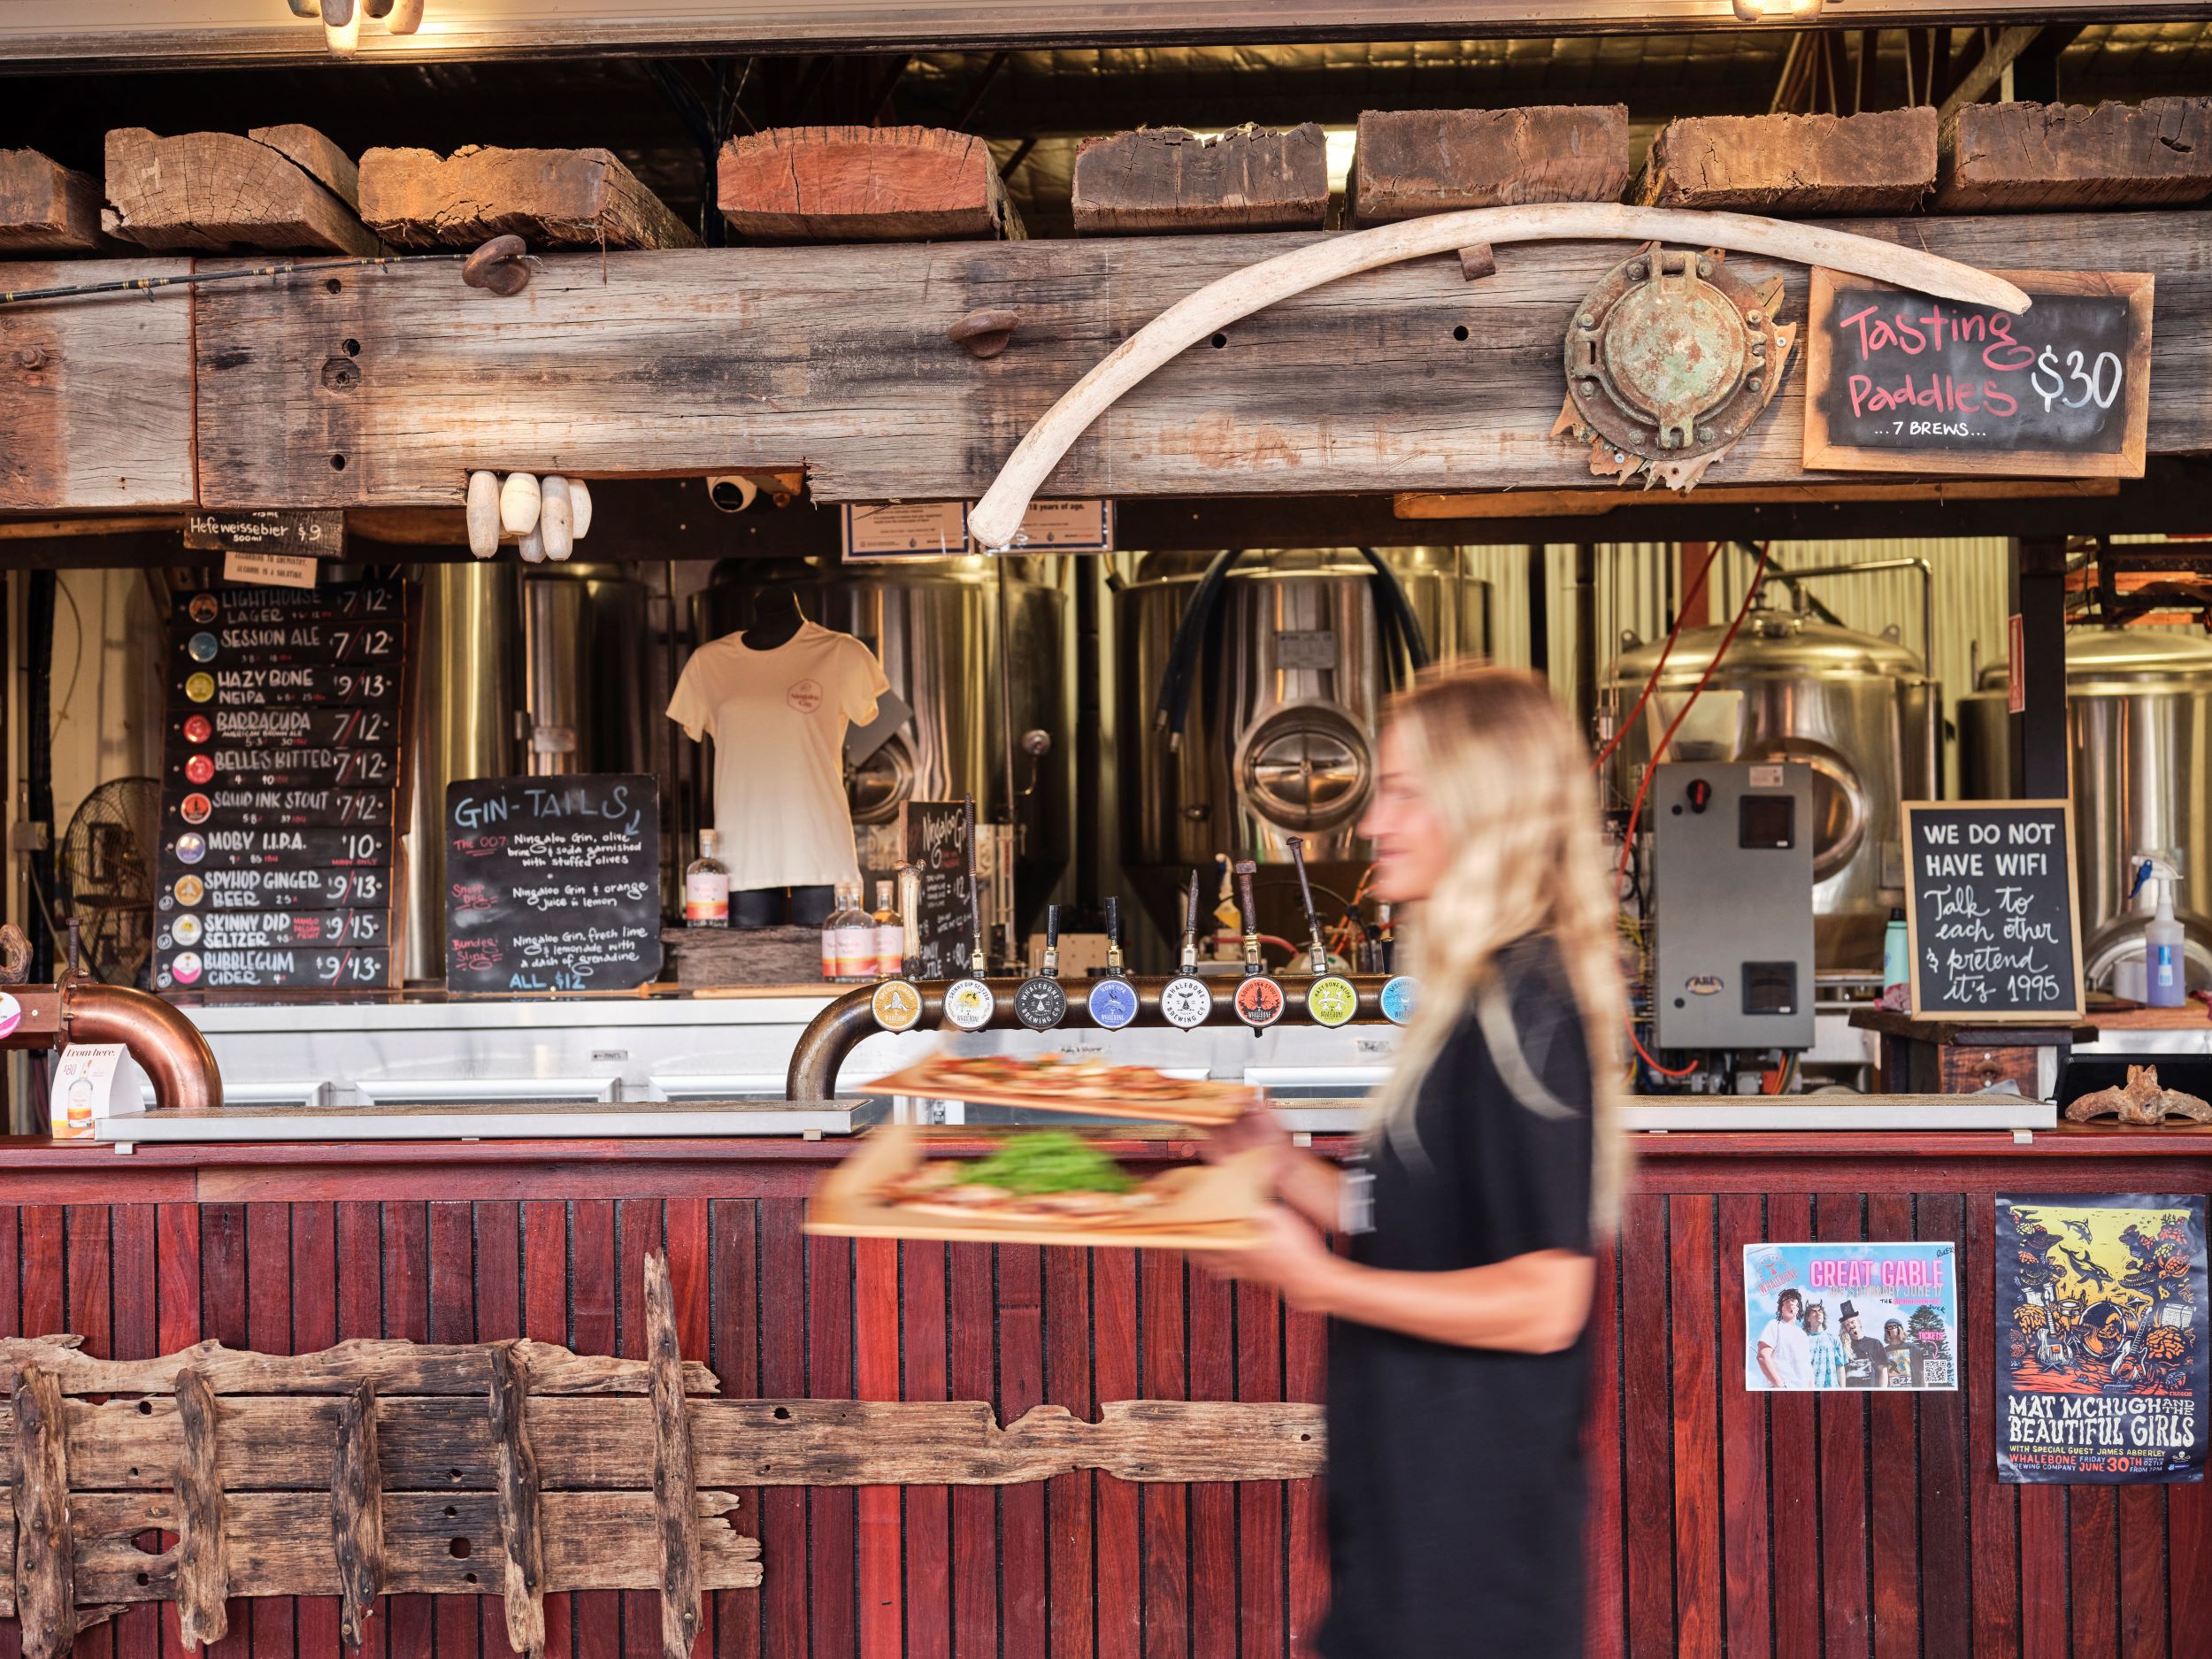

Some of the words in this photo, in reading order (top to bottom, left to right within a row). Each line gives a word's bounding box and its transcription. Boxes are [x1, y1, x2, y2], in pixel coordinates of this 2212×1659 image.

[1840, 303, 2036, 372] Tasting
[2032, 344, 2123, 413] $30
[1848, 373, 2019, 419] Paddles
[297, 523, 321, 542] $9
[222, 587, 322, 609] LIGHTHOUSE
[227, 608, 284, 625] LAGER
[221, 628, 286, 649] SESSION
[290, 626, 321, 647] ALE
[217, 670, 266, 688] HAZY
[268, 669, 314, 687] BONE
[219, 690, 265, 705] NEIPA
[216, 710, 311, 733] BARRACUDA
[275, 749, 331, 769] BITTER
[211, 791, 253, 810] SQUID
[255, 791, 281, 809] INK
[284, 790, 330, 811] STOUT
[208, 831, 255, 850] MOBY
[480, 835, 507, 848] 007
[514, 832, 566, 855] Ningaloo
[602, 831, 630, 842] olive
[1923, 824, 1960, 845] WE
[1968, 824, 2001, 845] DO
[2008, 823, 2056, 845] NOT
[556, 844, 583, 856] soda
[587, 841, 642, 860] garnished
[522, 856, 547, 867] with
[551, 855, 592, 868] stuffed
[595, 854, 629, 865] olives
[1925, 853, 1984, 877] HAVE
[1995, 853, 2047, 876] WIFI
[204, 870, 261, 890] SPYHOP
[264, 871, 322, 889] GINGER
[212, 891, 261, 908] BEER
[513, 886, 560, 905] Ningaloo
[564, 884, 586, 895] Gin
[603, 881, 649, 900] orange
[583, 896, 618, 908] lemon
[1924, 884, 1991, 922] Talk
[1995, 886, 2035, 915] to
[204, 912, 258, 932] SKINNY
[262, 912, 291, 931] DIP
[1935, 918, 1995, 943] each
[2003, 915, 2059, 944] other
[204, 932, 270, 949] SELTZER
[513, 934, 559, 956] Ningaloo
[588, 927, 618, 942] fresh
[622, 926, 649, 938] lime
[553, 941, 603, 955] lemonade
[608, 940, 635, 952] with
[203, 950, 295, 973] BUBBLEGUM
[520, 959, 528, 968] a
[531, 956, 558, 968] dash
[562, 954, 574, 968] of
[572, 951, 641, 977] grenadine
[1947, 945, 2049, 981] pretend
[208, 972, 262, 986] CIDER
[509, 973, 547, 989] ALL
[555, 971, 586, 990] $12
[1943, 973, 1997, 1003] it's
[2007, 974, 2060, 1002] 1995
[974, 983, 990, 1001] SELTZER
[1020, 983, 1060, 1001] WHALEBONE
[1166, 982, 1205, 999] WHALEBONE
[1021, 1008, 1052, 1025] BREWING
[1166, 1006, 1197, 1023] BREWING
[1809, 1259, 1874, 1288] GREAT
[1880, 1259, 1945, 1288] GABLE
[1918, 1331, 1944, 1341] TICKETS
[2008, 1394, 2056, 1418] MAT
[2060, 1395, 2162, 1419] MCHUGH
[2162, 1398, 2194, 1408] AND
[2162, 1406, 2194, 1416] THE
[2008, 1415, 2124, 1446] BEAUTIFUL
[2130, 1414, 2194, 1448] GIRLS
[2009, 1454, 2078, 1465] WHALEBONE
[2126, 1448, 2166, 1457] ABBERLEY
[2079, 1463, 2105, 1472] JUNE
